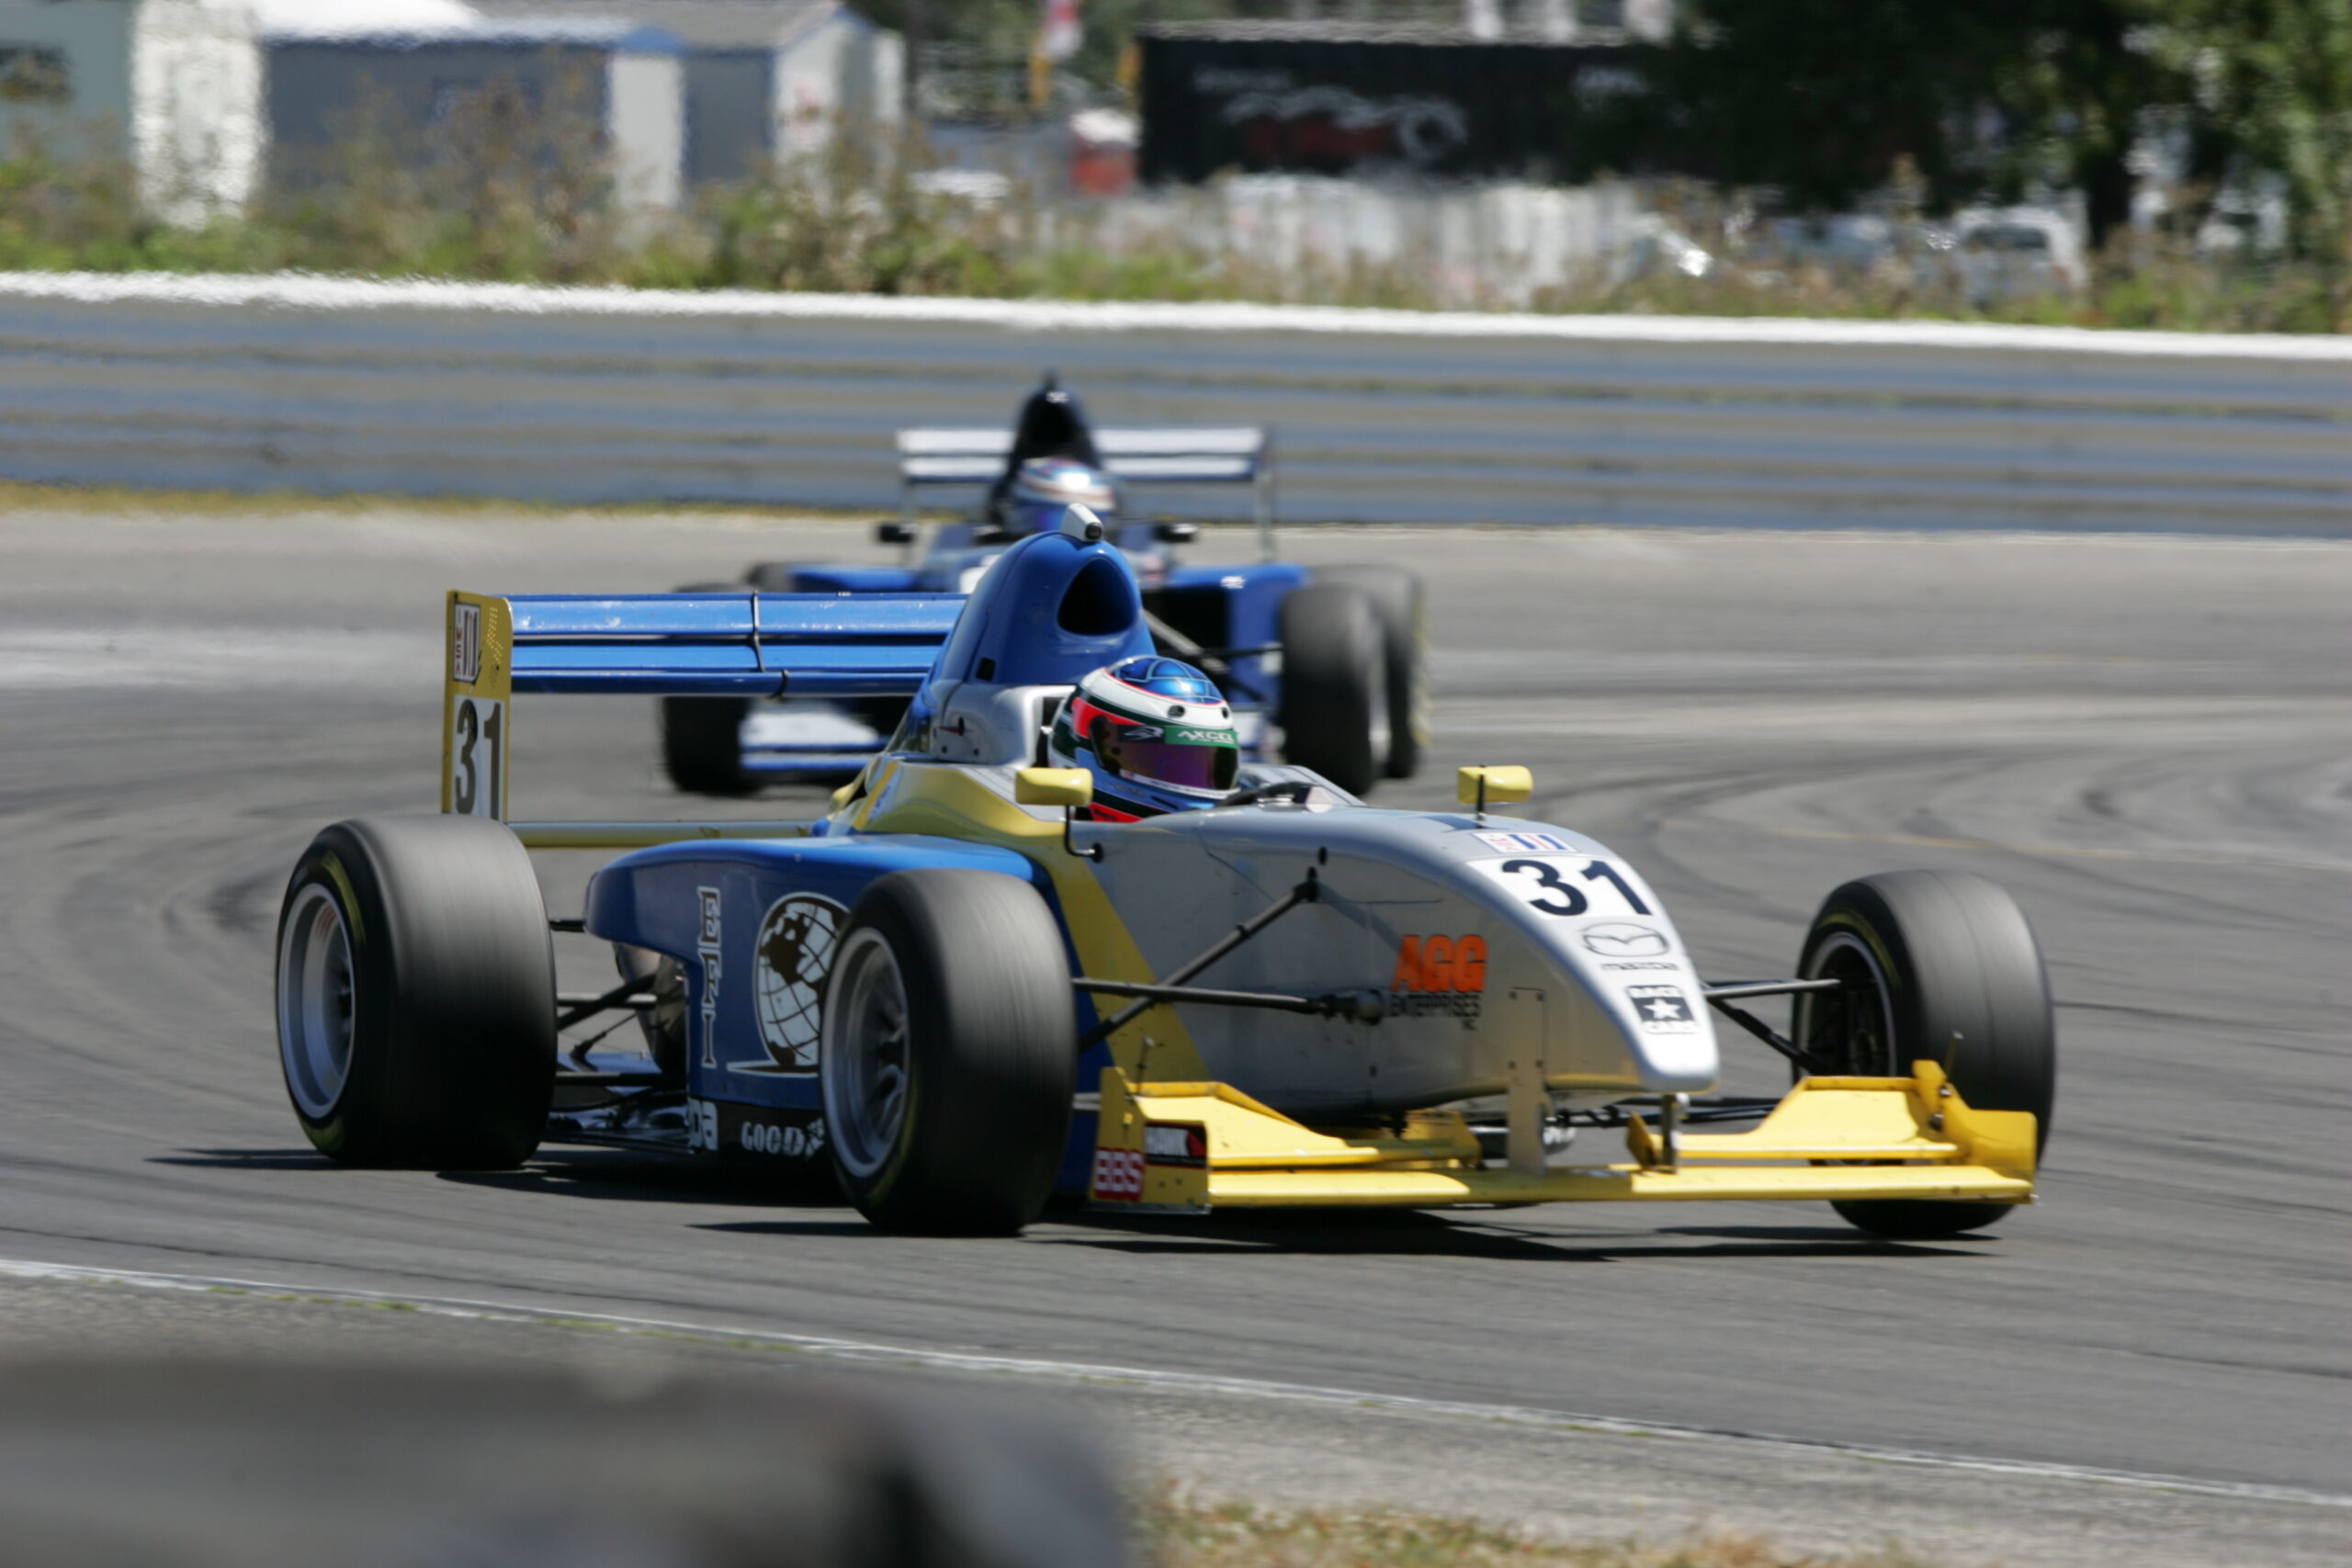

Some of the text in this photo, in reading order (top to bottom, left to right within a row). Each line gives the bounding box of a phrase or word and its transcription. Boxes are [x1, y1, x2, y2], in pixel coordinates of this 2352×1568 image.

[455, 698, 503, 822] 31
[1501, 859, 1654, 917] 31
[1390, 933, 1488, 993] AGG
[1094, 1150, 1143, 1193] BBS
